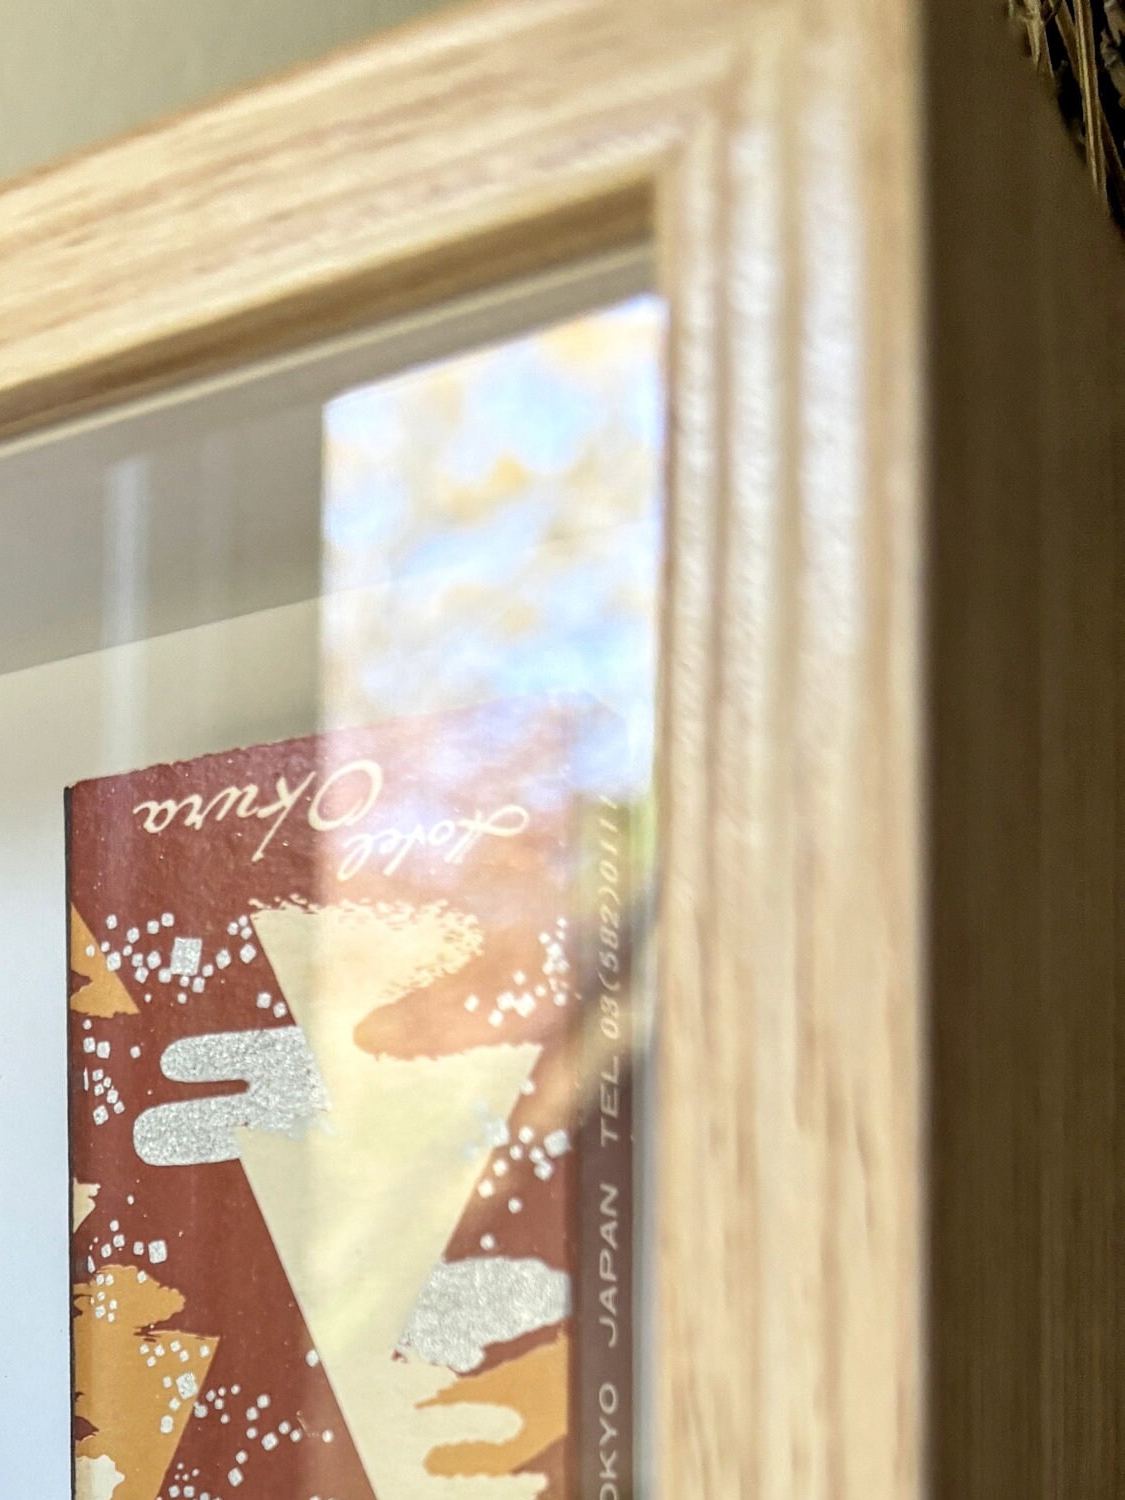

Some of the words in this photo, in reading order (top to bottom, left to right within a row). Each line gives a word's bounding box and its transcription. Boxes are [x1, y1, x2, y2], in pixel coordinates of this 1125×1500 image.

[132, 758, 384, 863] Okura
[335, 803, 530, 882] Hotel
[599, 1055, 621, 1148] TEL
[598, 1182, 620, 1348] JAPAN
